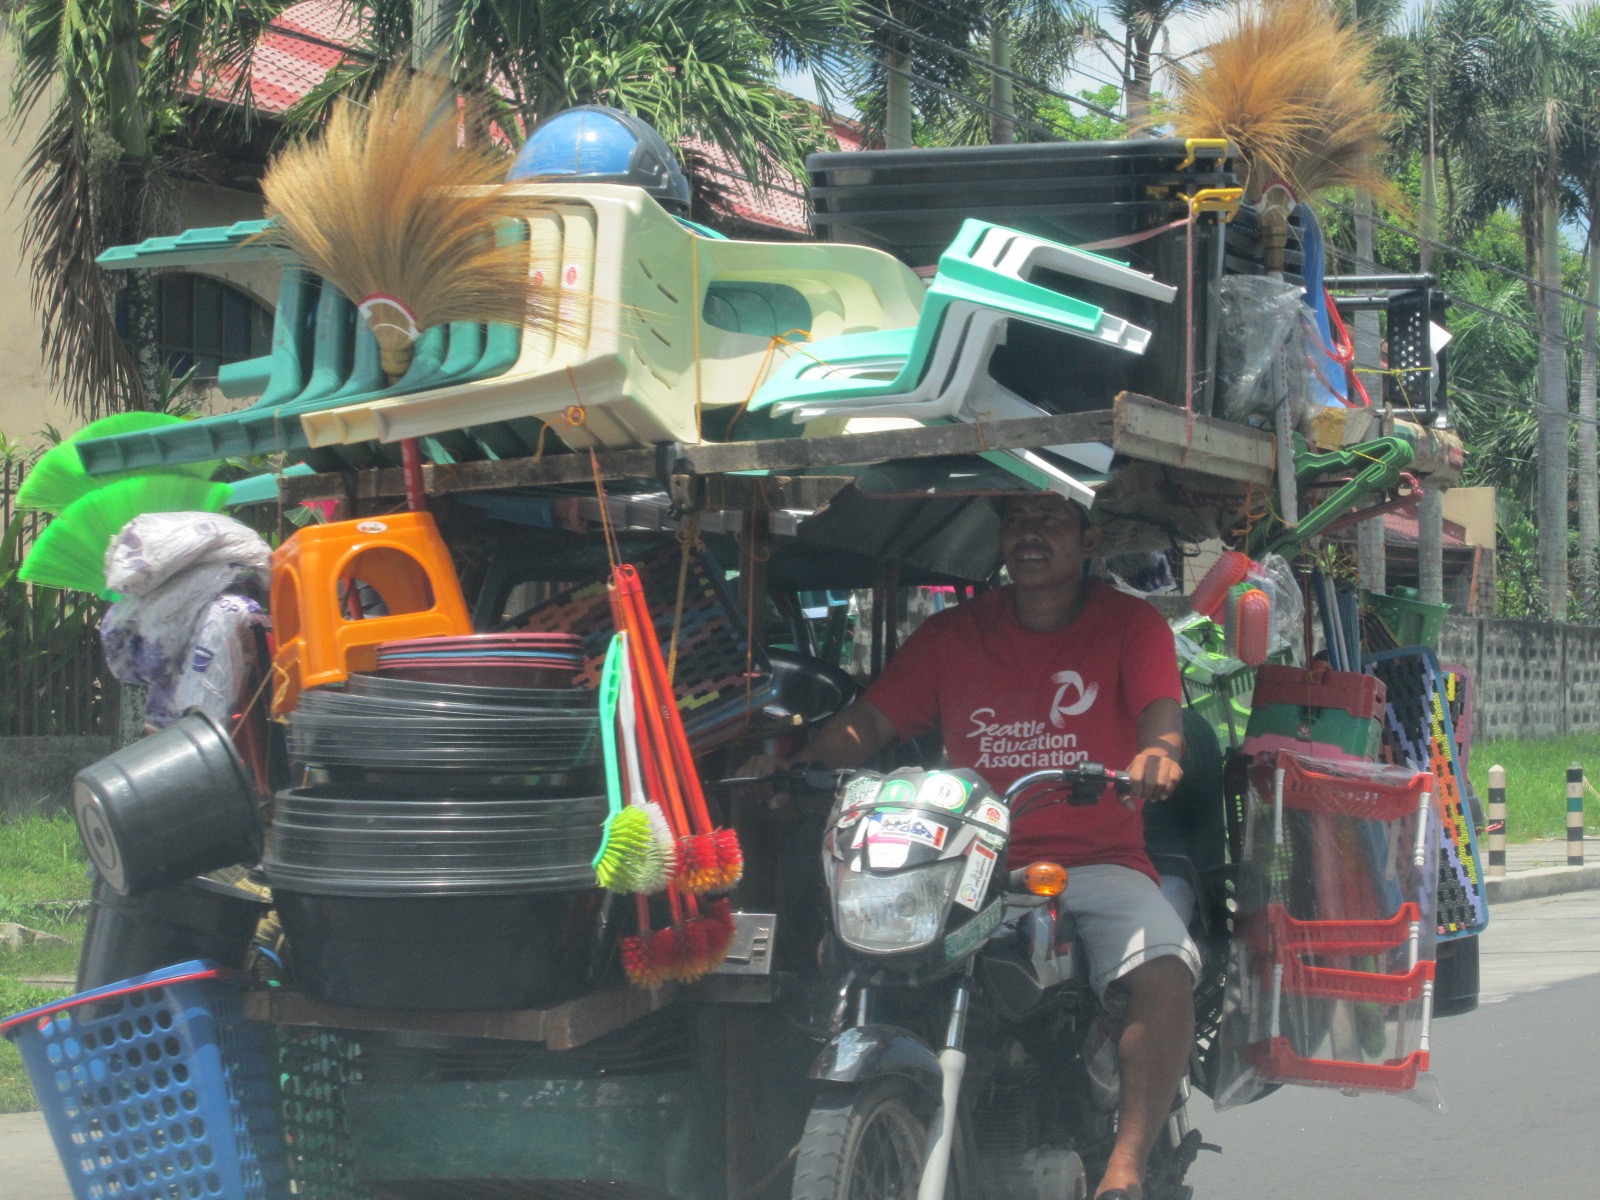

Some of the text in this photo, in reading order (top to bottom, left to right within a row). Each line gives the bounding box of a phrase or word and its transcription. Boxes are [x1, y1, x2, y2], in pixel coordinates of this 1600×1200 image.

[966, 708, 1046, 738] Seattle
[980, 733, 1077, 753] Education
[974, 750, 1089, 768] Association
